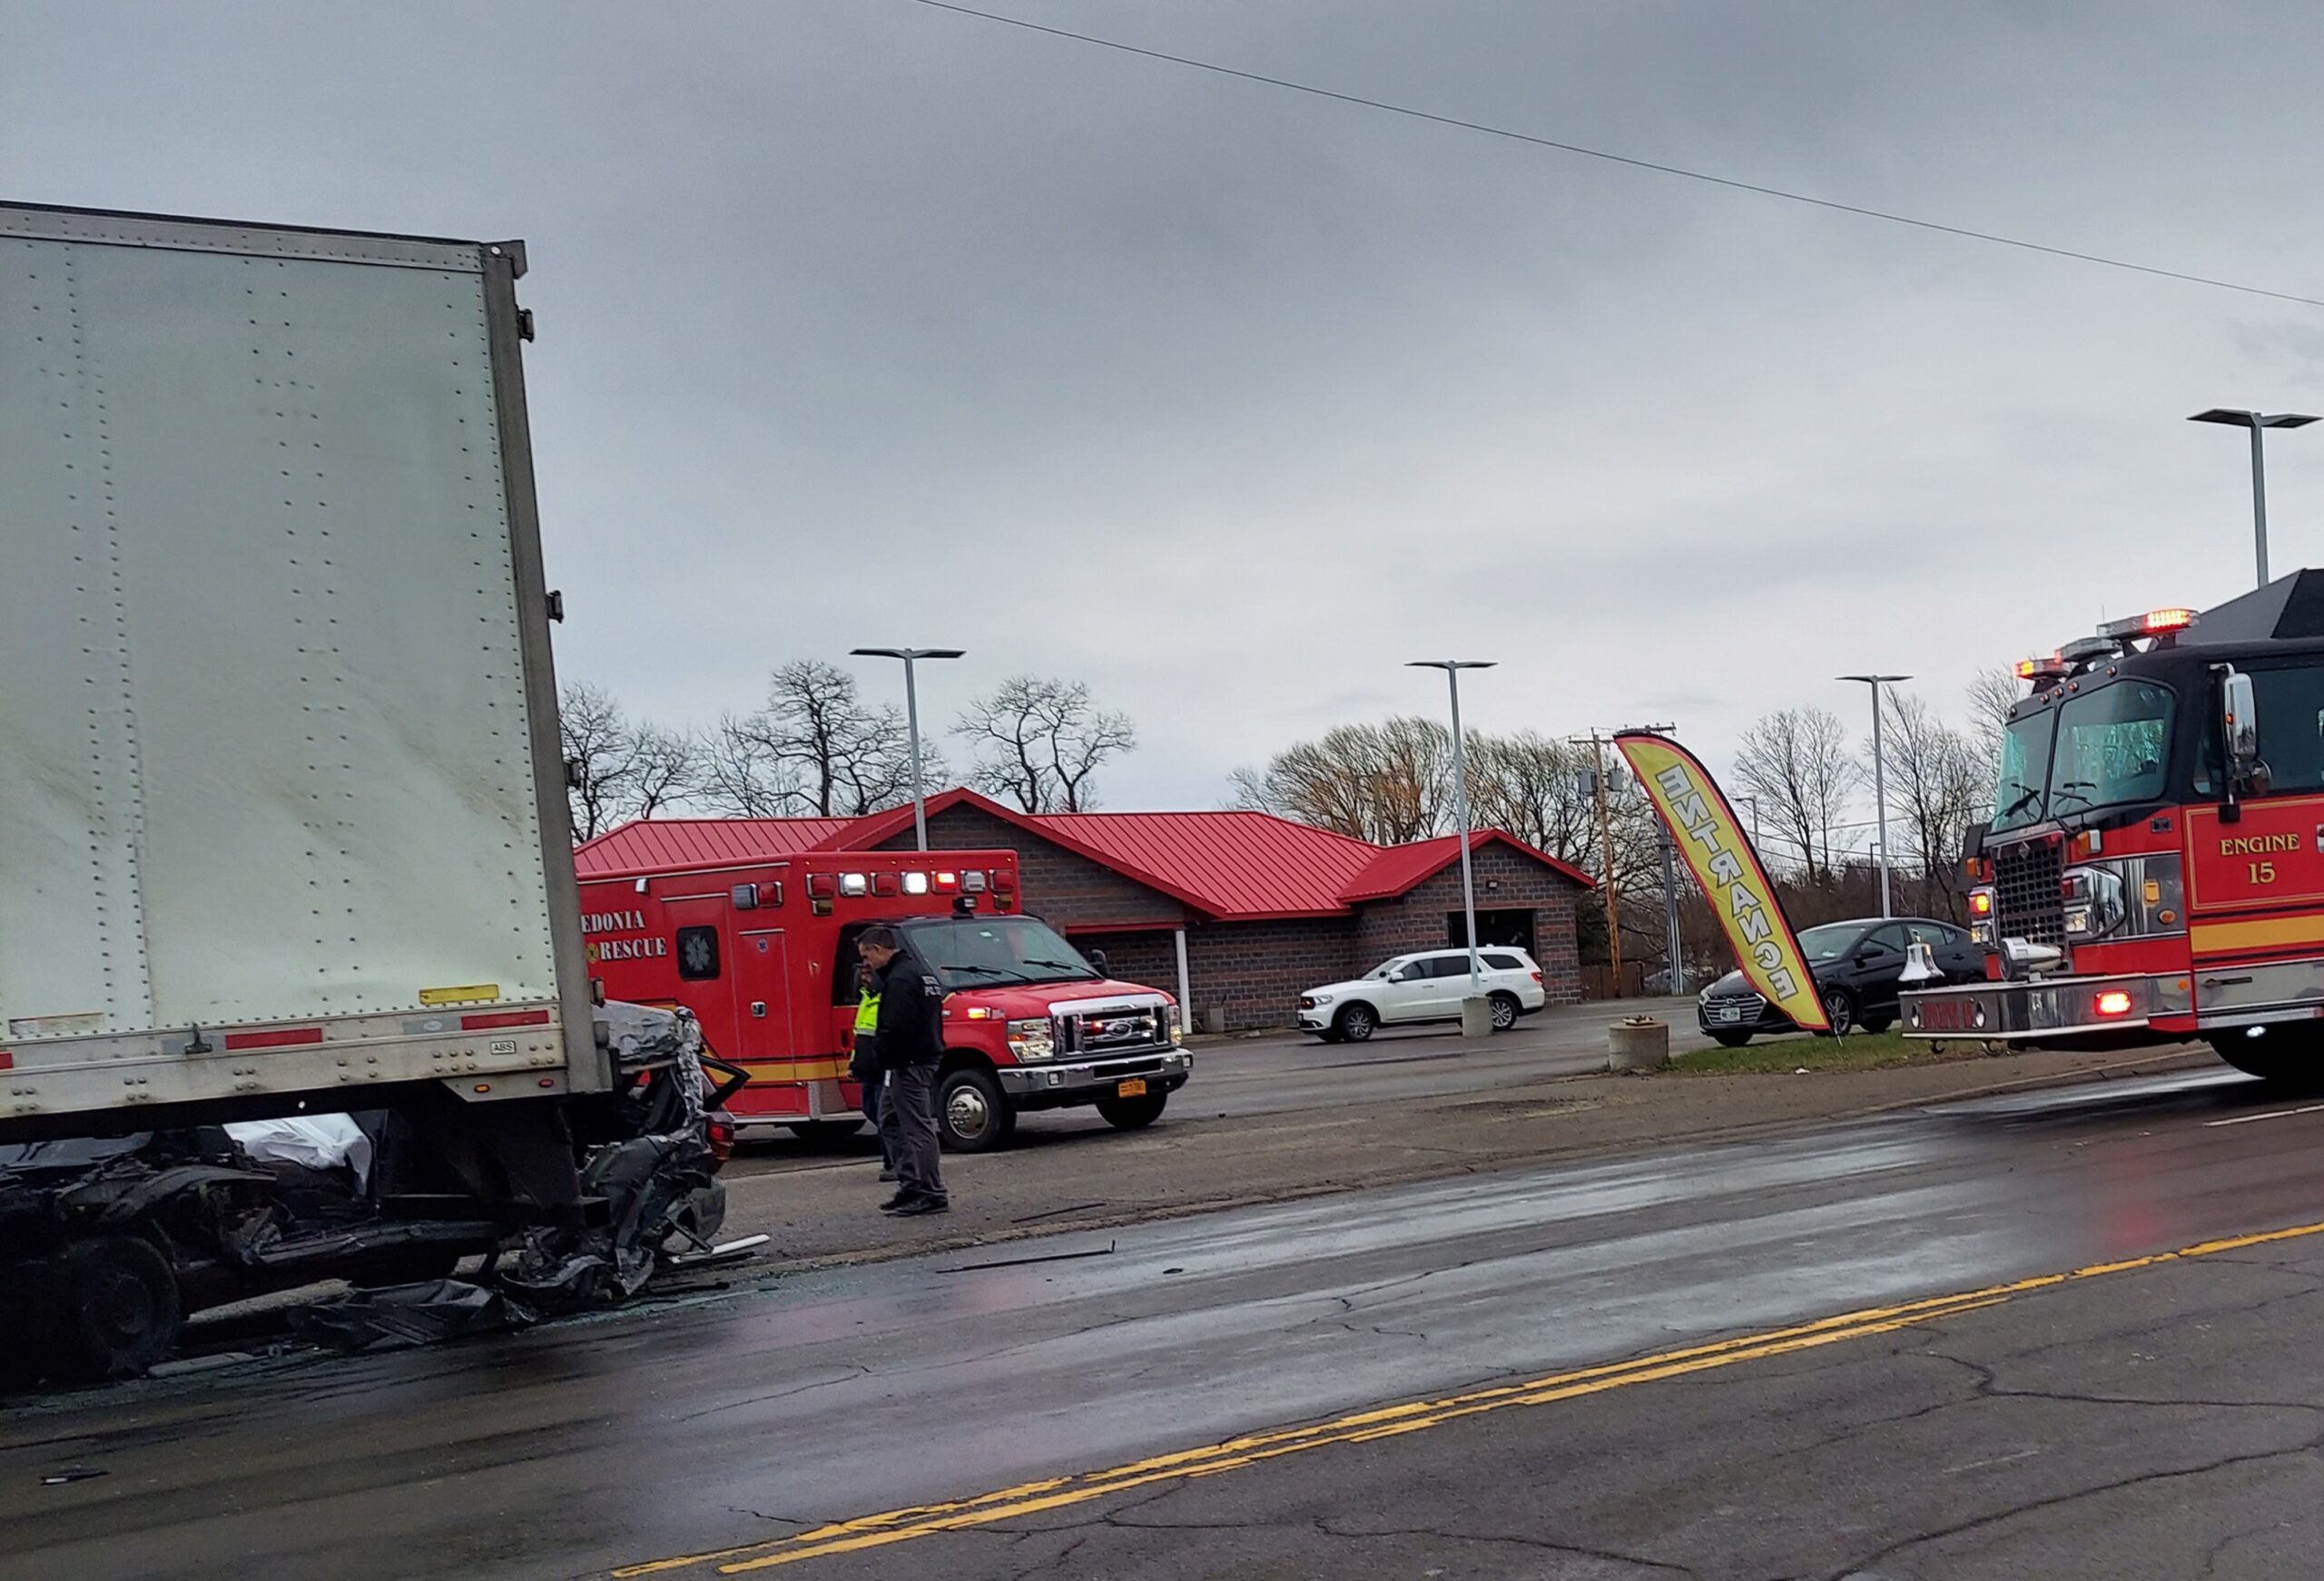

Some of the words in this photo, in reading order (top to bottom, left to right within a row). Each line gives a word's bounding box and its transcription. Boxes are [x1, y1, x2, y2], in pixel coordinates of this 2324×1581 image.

[2221, 833, 2300, 856] ENGINE
[2249, 861, 2276, 885] 15
[600, 938, 667, 960] RESCUE
